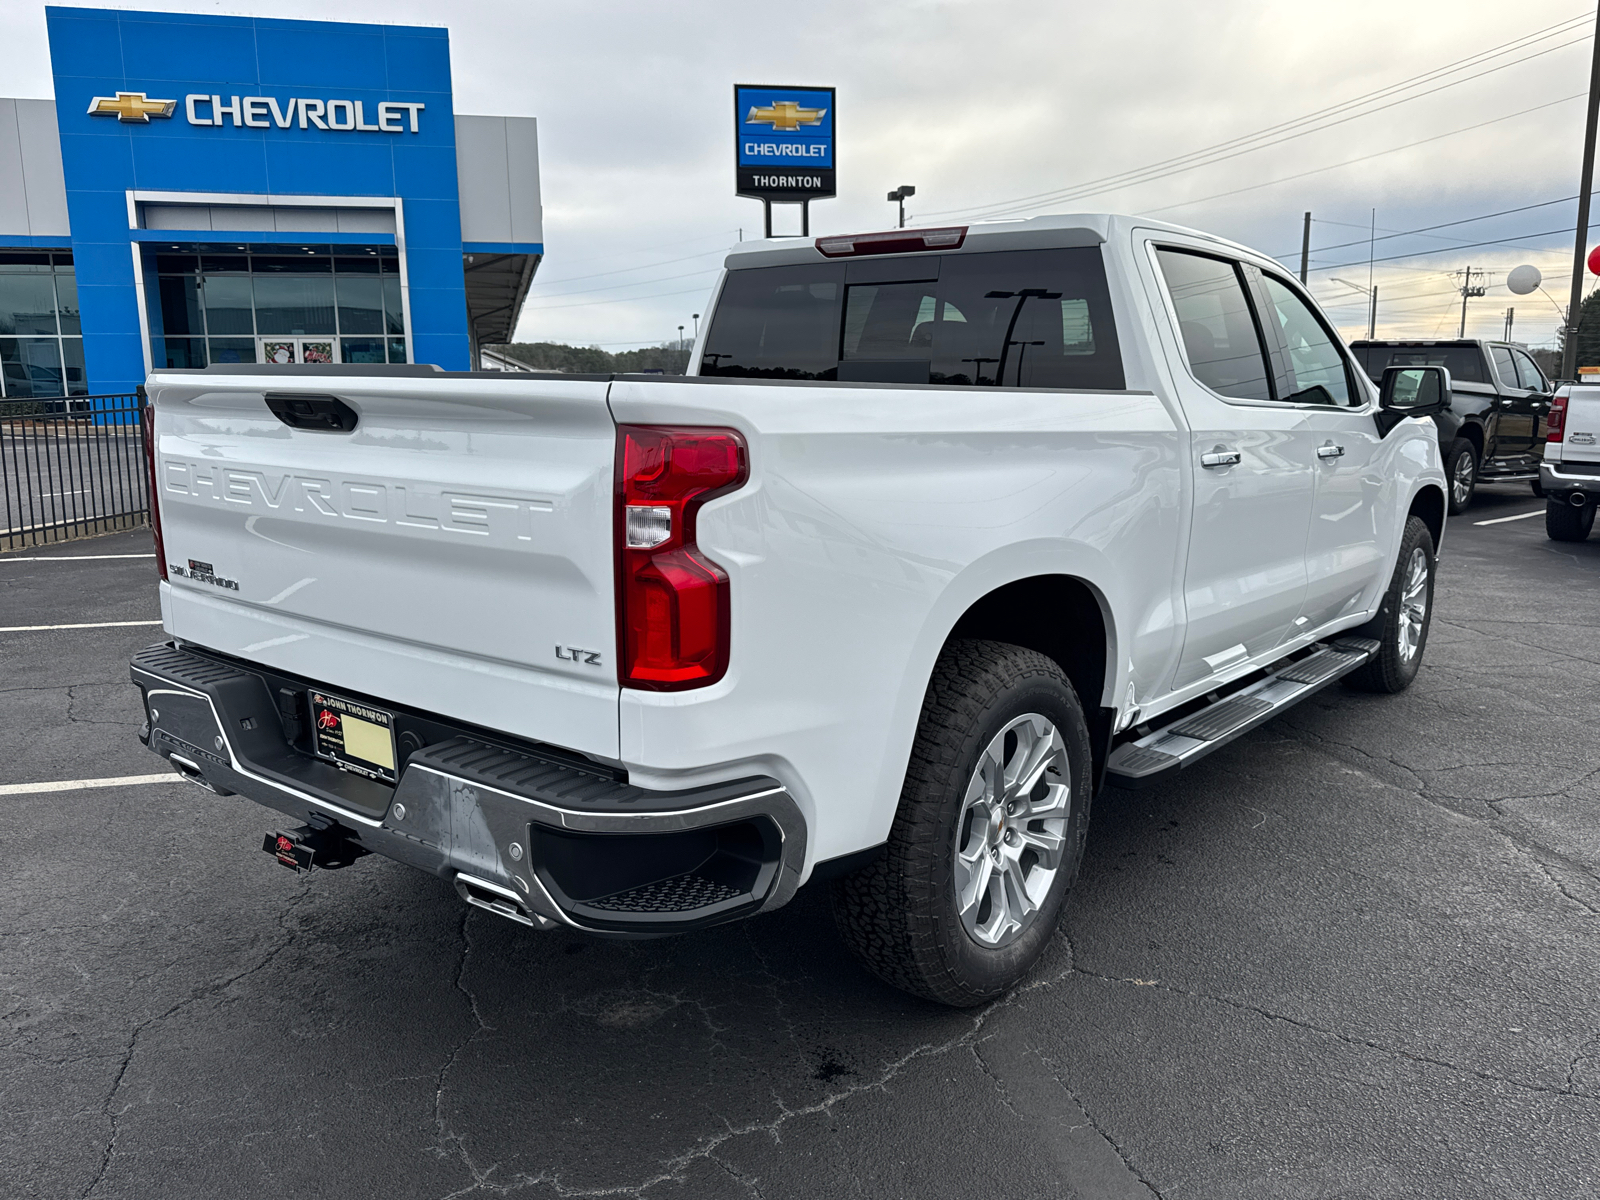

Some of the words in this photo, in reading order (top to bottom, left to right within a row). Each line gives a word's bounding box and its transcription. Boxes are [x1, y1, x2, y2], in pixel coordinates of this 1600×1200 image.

[186, 94, 425, 133] CHEVROLET
[745, 143, 827, 157] CHEVROLET
[752, 175, 821, 188] THORNTON
[164, 460, 553, 540] CHEVROLET
[169, 564, 239, 591] SILVERADO
[555, 644, 602, 666] LTZ
[327, 697, 347, 711] JOHN
[347, 704, 388, 724] THORNTON
